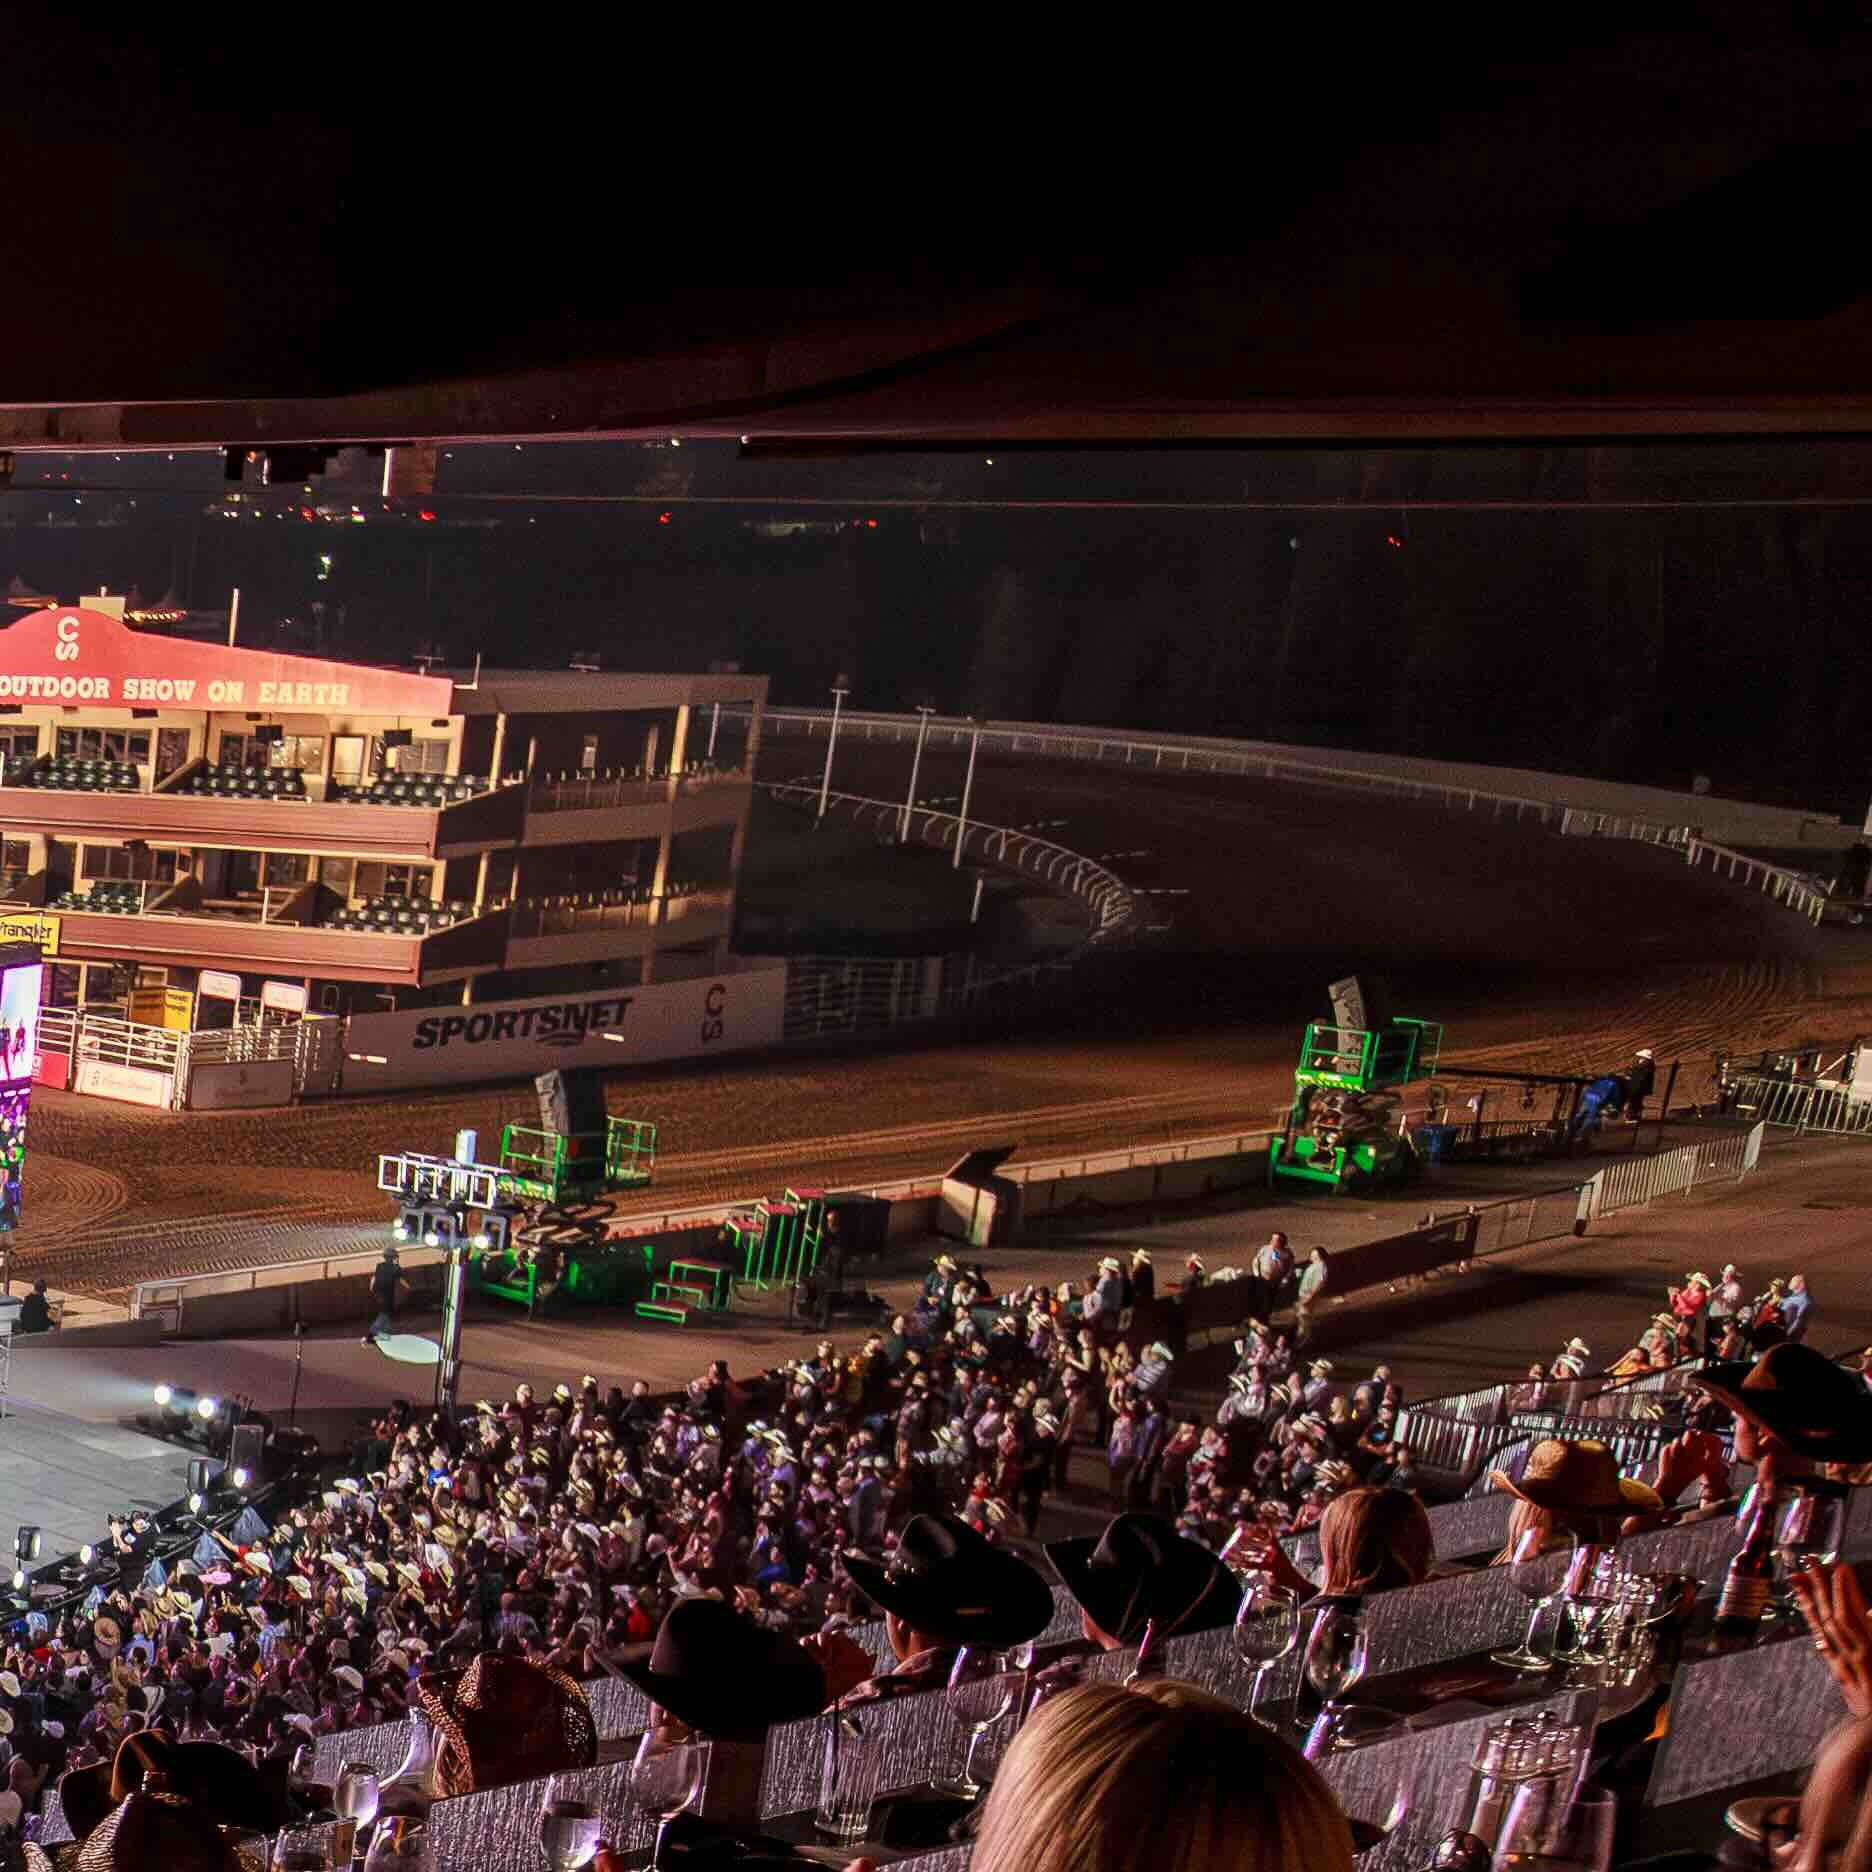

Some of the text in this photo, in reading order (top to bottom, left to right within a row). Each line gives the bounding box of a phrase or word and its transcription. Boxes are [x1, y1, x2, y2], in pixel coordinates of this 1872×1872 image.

[122, 677, 196, 701] SHOW
[207, 681, 244, 705] ON
[259, 682, 350, 706] EARTH
[412, 997, 635, 1050] SPORTSNET
